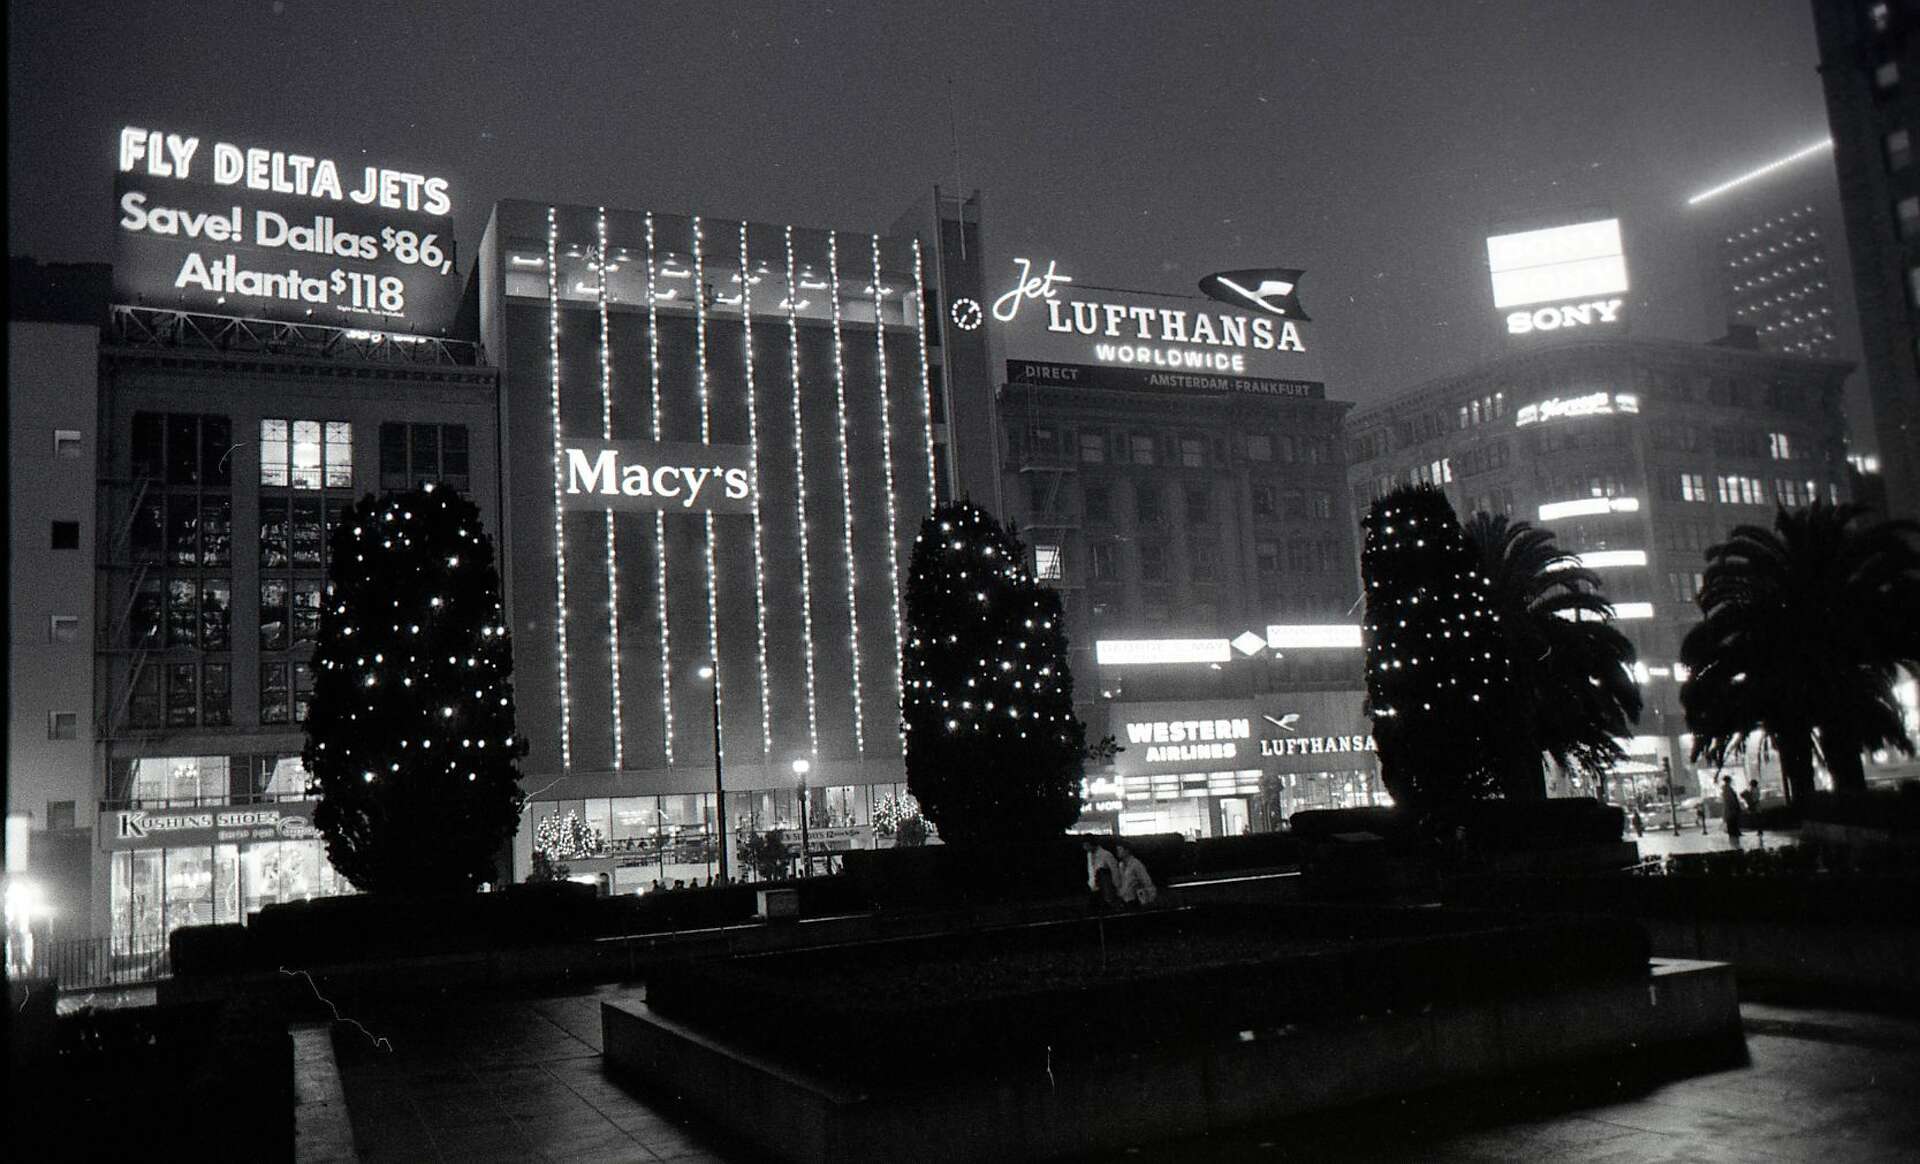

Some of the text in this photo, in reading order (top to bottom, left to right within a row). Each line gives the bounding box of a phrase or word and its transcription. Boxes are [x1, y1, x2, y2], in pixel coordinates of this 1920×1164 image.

[119, 126, 451, 215] FLY DELTA JETS
[120, 192, 452, 275] Save! Dallas $86,
[175, 252, 404, 312] Atlanta $118
[992, 258, 1072, 321] Jet
[1046, 299, 1306, 352] LUFTHANSA
[1506, 300, 1622, 333] SONY
[1095, 344, 1245, 371] WORLDWIDE
[1024, 365, 1310, 397] DIRECT AMSTERDAM FRANKFURT
[1126, 719, 1250, 743] WESTERN
[1260, 735, 1378, 756] LUFTHANSA
[1146, 743, 1237, 762] AIRLINES
[117, 811, 213, 839] KUSHINS
[216, 811, 280, 827] SHOES
